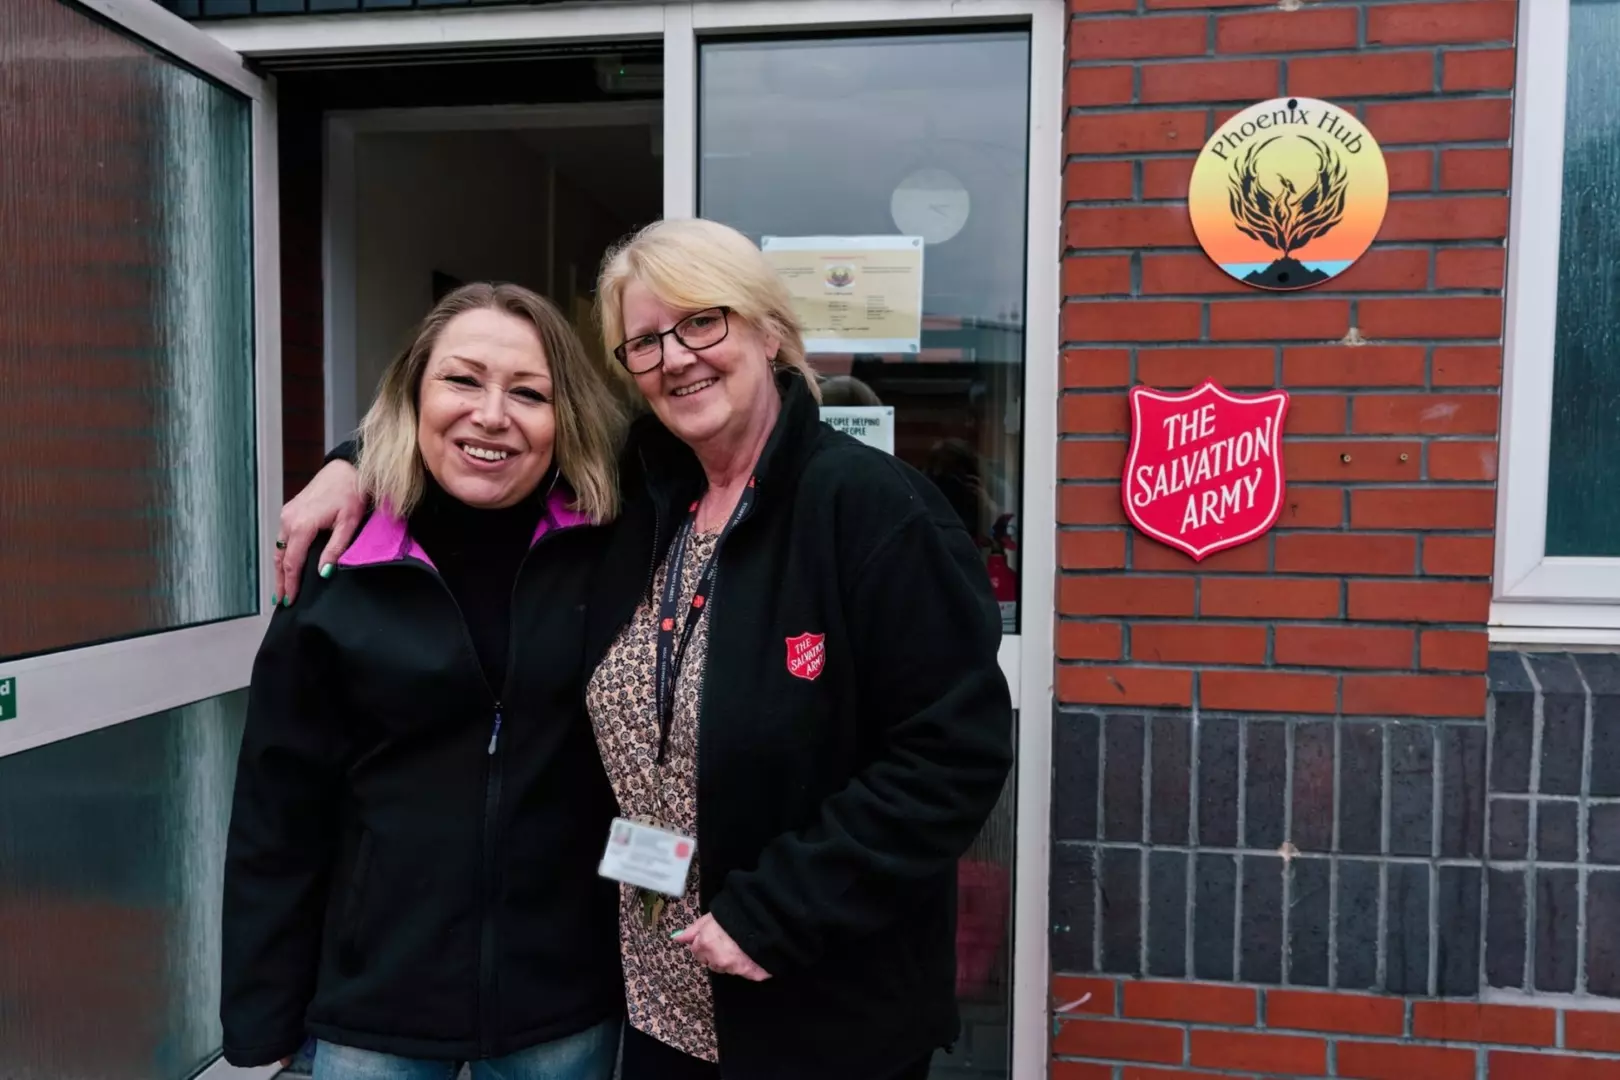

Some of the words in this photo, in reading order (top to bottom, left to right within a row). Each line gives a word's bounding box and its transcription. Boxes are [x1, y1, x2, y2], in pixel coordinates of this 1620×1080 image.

[1211, 108, 1310, 161] Phoenix
[1316, 110, 1363, 155] Hub
[825, 417, 849, 428] PEOPLE
[852, 417, 880, 427] HELPING
[1163, 403, 1216, 451] THE
[1133, 416, 1272, 507] SALVATION
[1180, 467, 1263, 534] ARMY
[791, 642, 824, 671] SALVATIO
[794, 638, 811, 655] THE
[807, 654, 823, 676] ARMY
